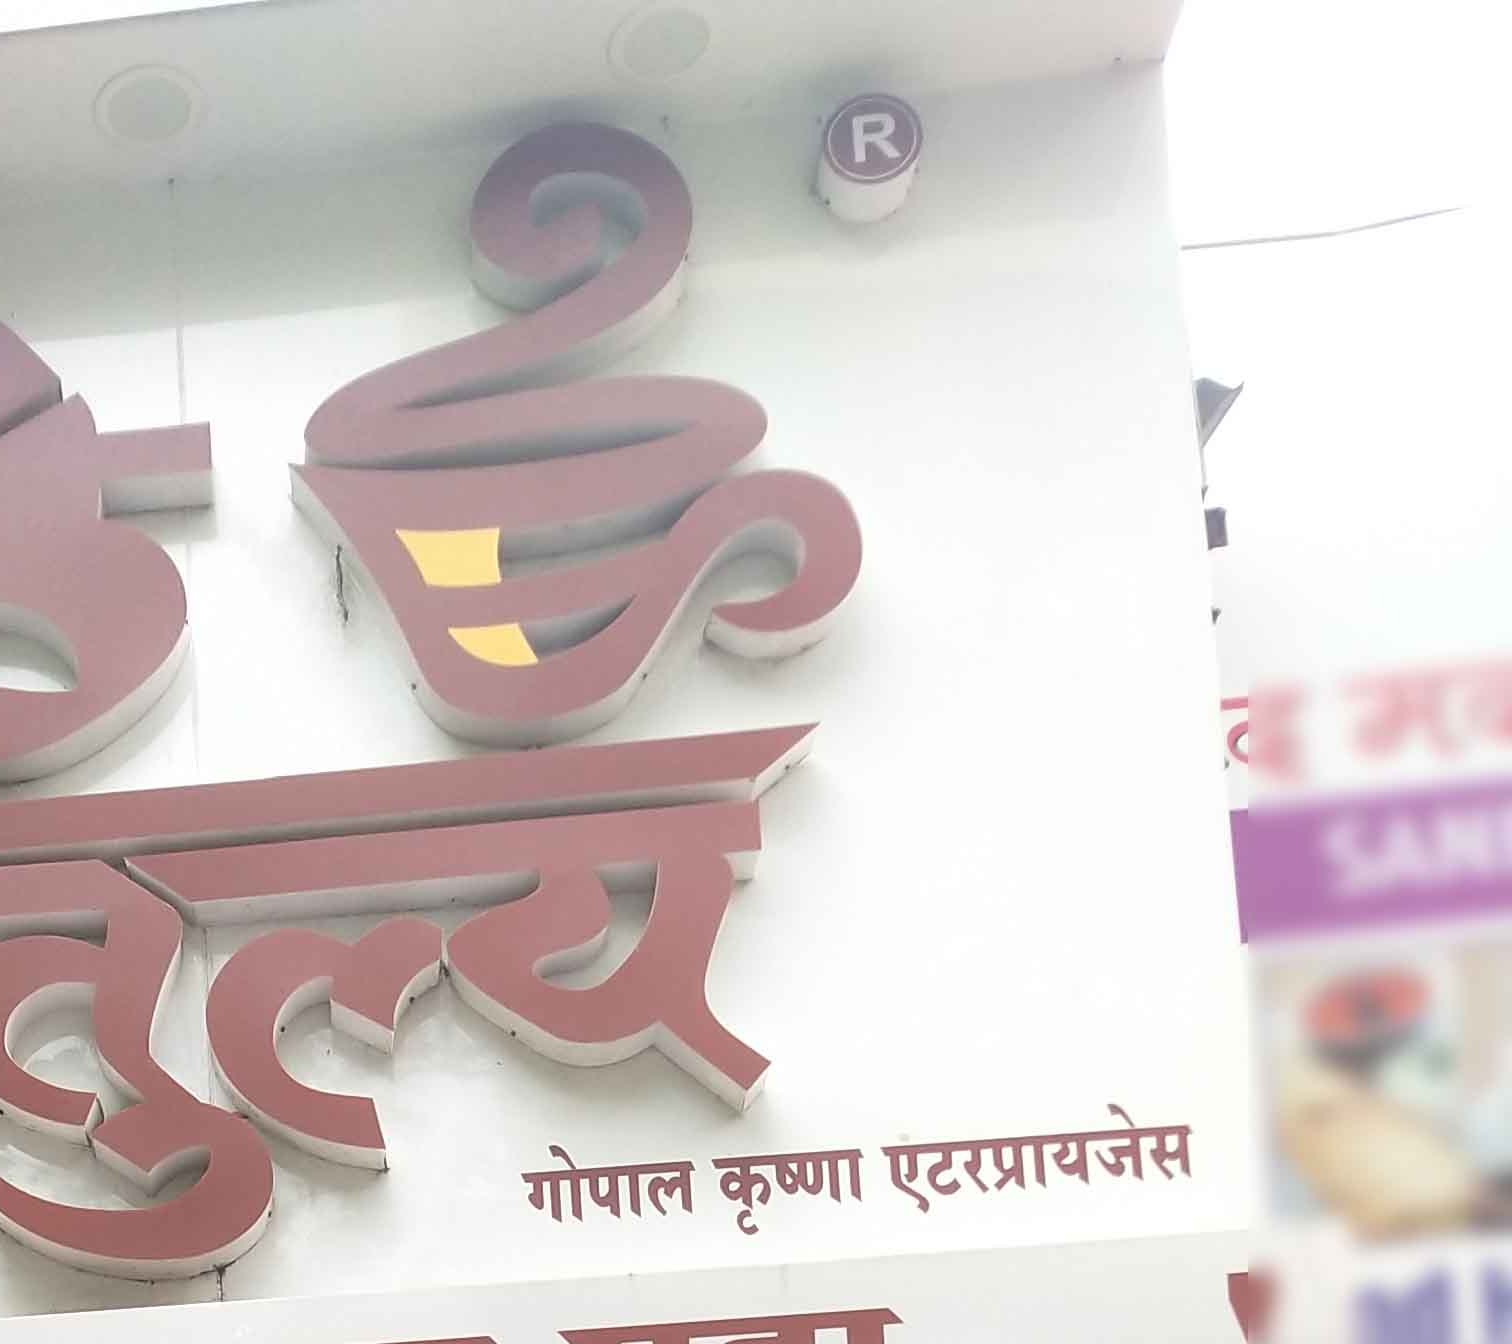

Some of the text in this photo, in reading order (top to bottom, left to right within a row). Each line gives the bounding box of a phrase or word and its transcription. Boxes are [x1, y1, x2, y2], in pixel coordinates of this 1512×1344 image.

[850, 112, 902, 164] R
[521, 1145, 696, 1223] गोपाल
[712, 1147, 863, 1236] कृष्णा
